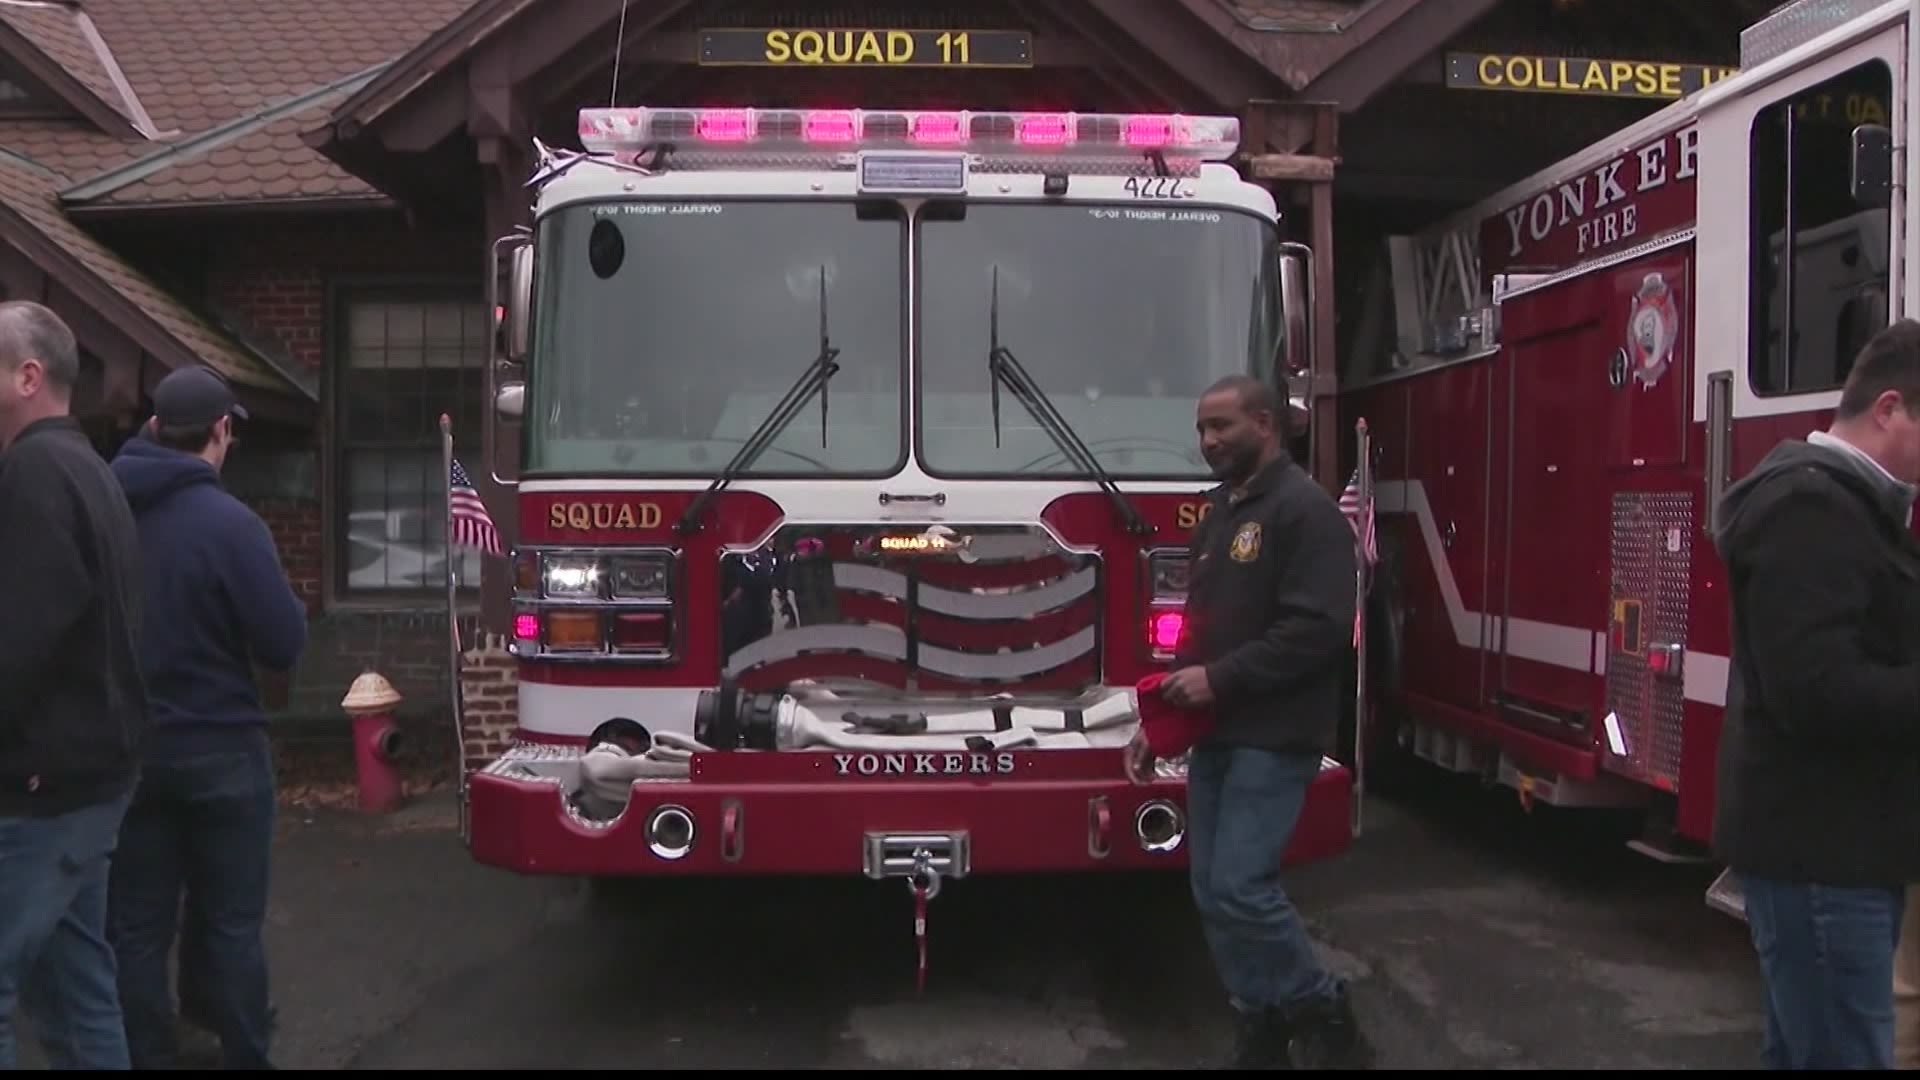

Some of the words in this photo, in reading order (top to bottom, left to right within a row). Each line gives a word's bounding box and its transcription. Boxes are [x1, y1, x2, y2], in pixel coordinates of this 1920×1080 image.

[765, 30, 915, 64] SQUAD
[936, 31, 969, 64] 11
[1478, 55, 1682, 95] COLLAPSE
[1577, 204, 1637, 253] FIRE
[550, 502, 662, 530] SQUAD
[880, 536, 928, 549] SQUAD
[833, 752, 1017, 775] YONKERS
